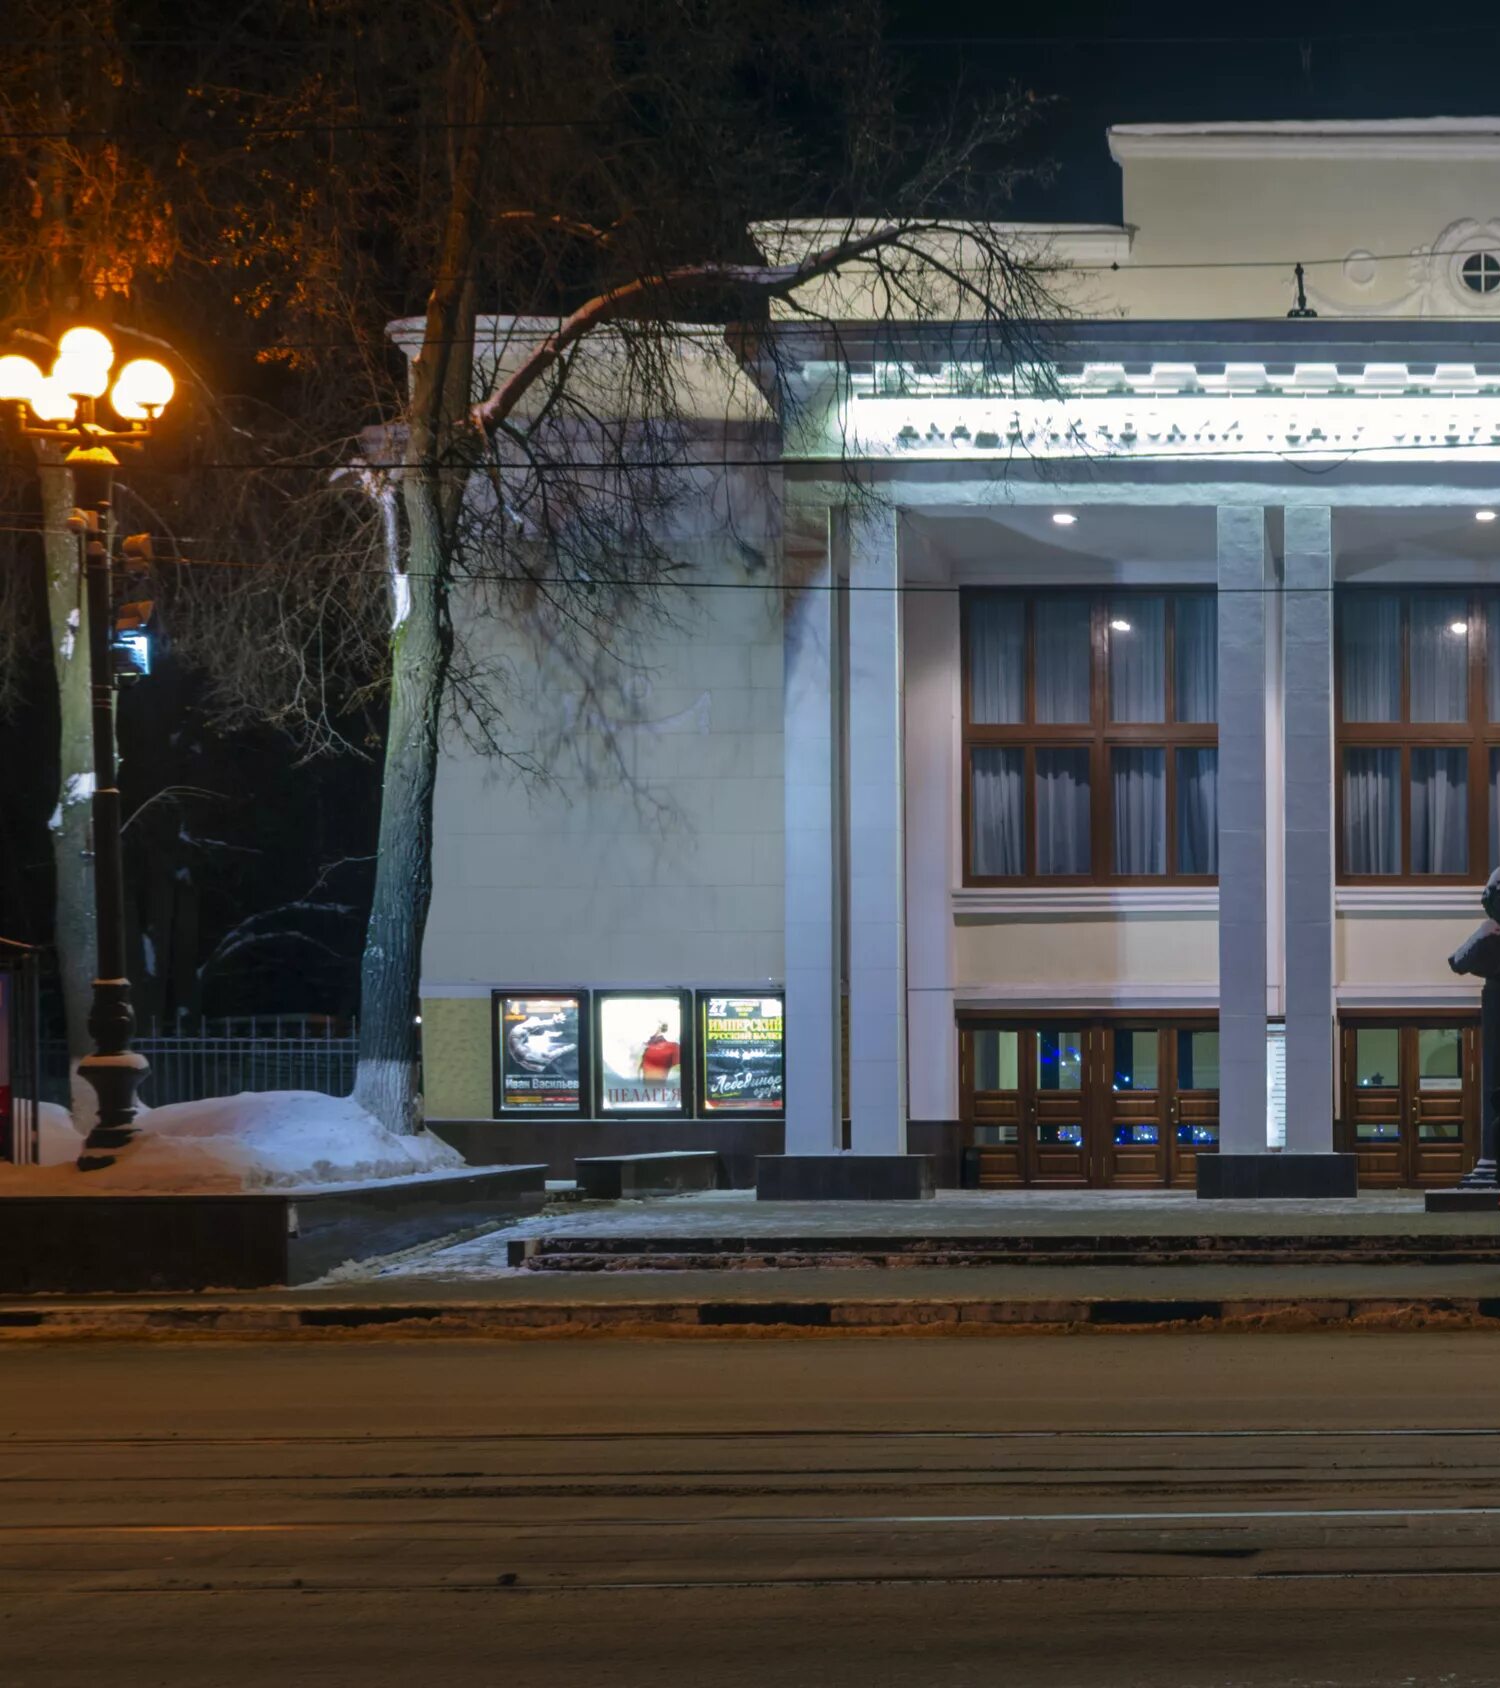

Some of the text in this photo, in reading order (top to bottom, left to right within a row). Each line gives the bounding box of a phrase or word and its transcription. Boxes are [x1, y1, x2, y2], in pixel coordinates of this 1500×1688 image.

[708, 1016, 782, 1031] ИМПЕРСКИЙ
[708, 1032, 752, 1040] РУССКИЙ
[505, 1078, 579, 1088] Иван Васильев
[711, 1072, 782, 1094] Лебединое
[609, 1088, 681, 1103] ПЕЛАГЕЯ
